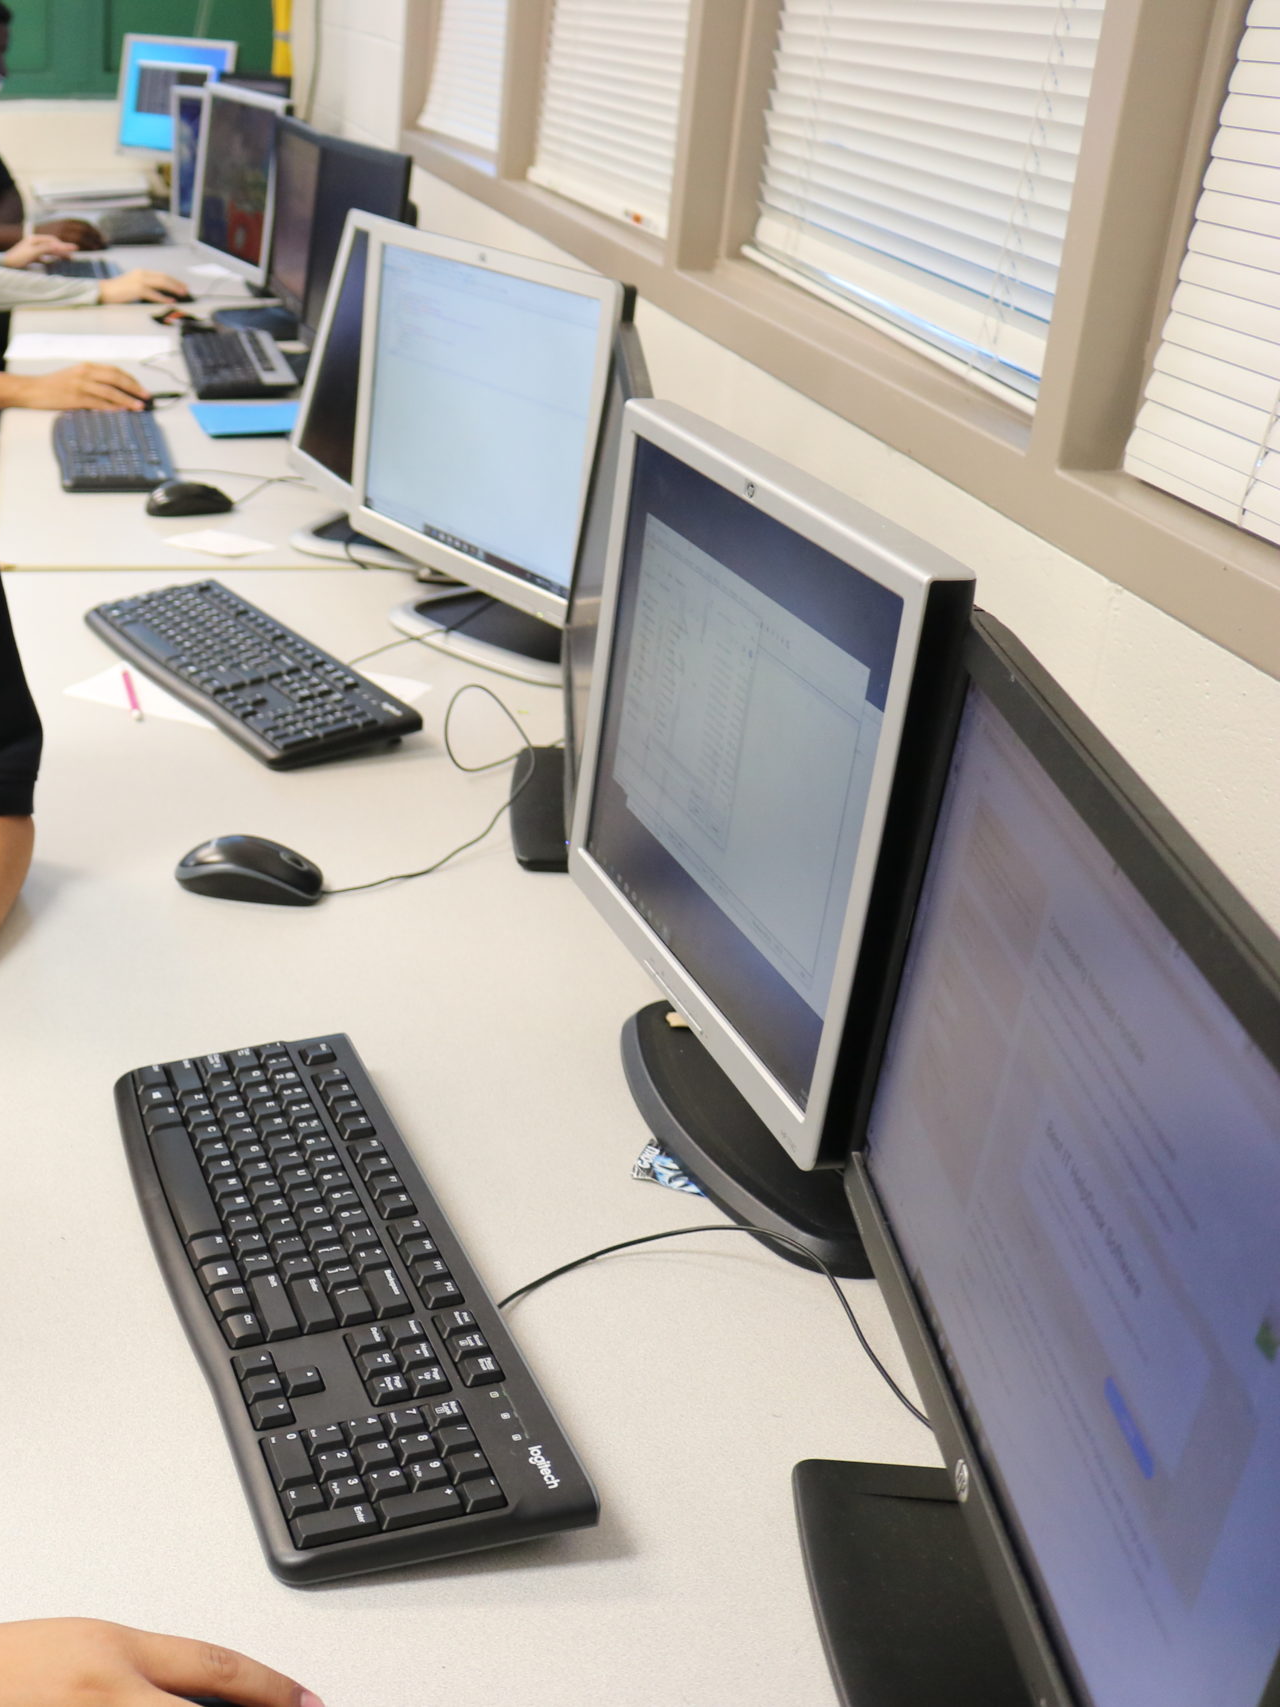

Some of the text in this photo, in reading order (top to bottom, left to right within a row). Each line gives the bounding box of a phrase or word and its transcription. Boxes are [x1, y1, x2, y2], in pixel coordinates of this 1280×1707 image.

[423, 1240, 432, 1250] F10
[434, 1261, 443, 1270] F11
[268, 1276, 277, 1287] Shift
[309, 1279, 319, 1292] Enter
[384, 1270, 400, 1295] Backspace
[444, 1282, 455, 1292] F12
[244, 1315, 253, 1324] Ctrl
[408, 1320, 419, 1334] Insert
[371, 1327, 381, 1342] Delete
[420, 1343, 429, 1357] Home
[383, 1354, 392, 1364] End
[431, 1368, 440, 1380] Page
[384, 1377, 394, 1390] Down
[393, 1376, 402, 1388] Page
[528, 1445, 561, 1489] logitech
[354, 1506, 365, 1523] Enter
